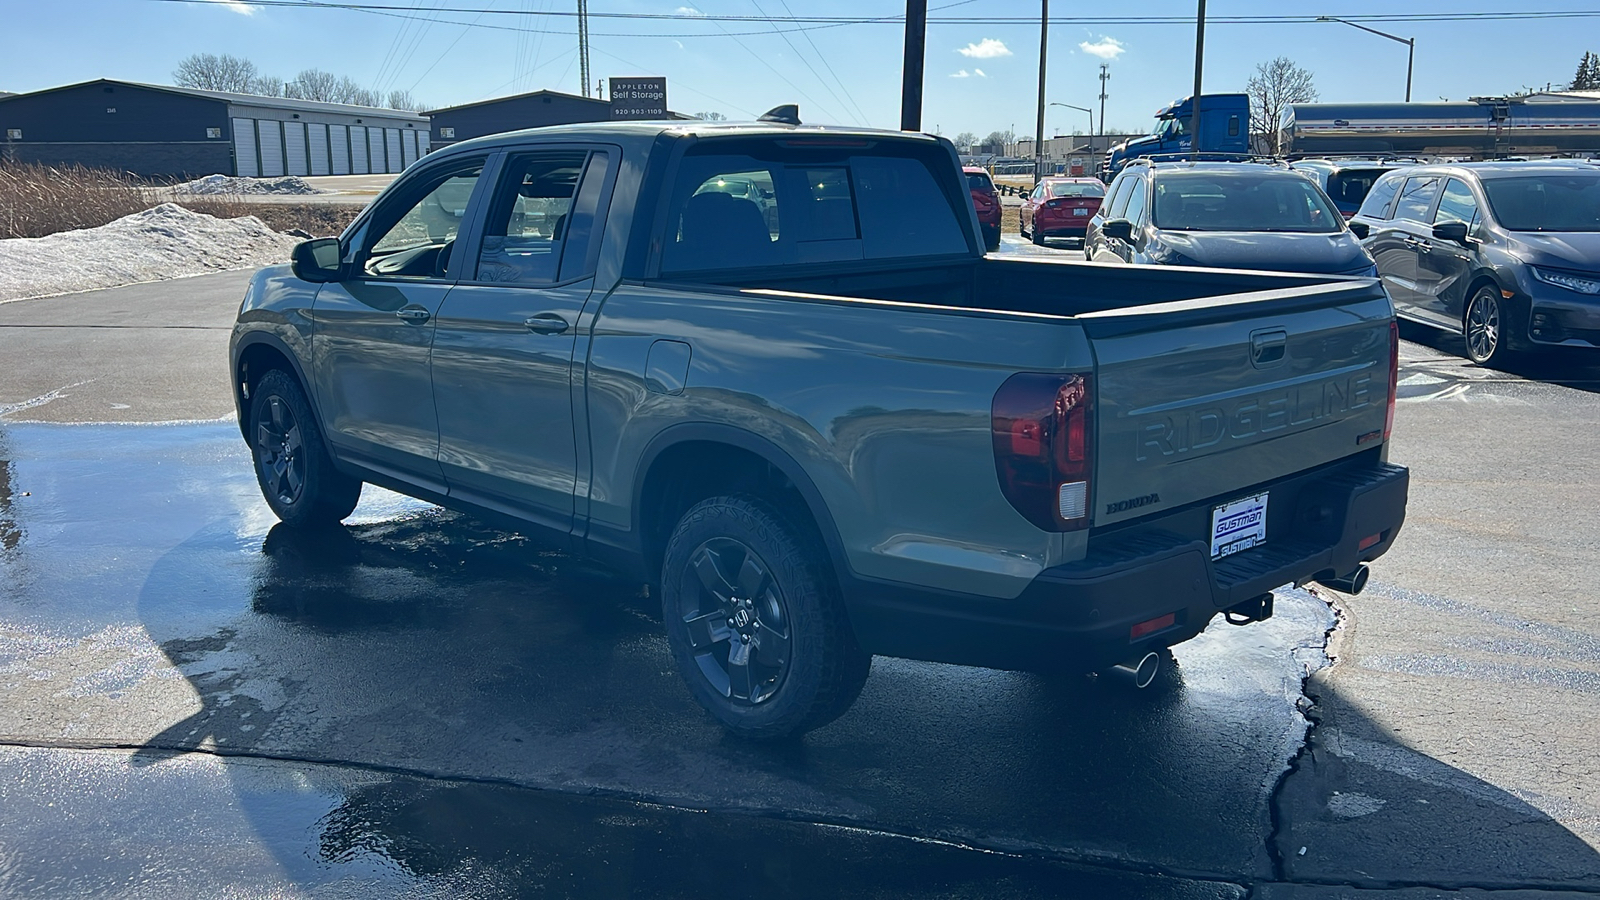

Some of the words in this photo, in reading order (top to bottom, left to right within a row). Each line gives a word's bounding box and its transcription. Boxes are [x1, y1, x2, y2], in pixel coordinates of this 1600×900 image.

[612, 91, 629, 99] Self
[631, 91, 664, 100] Storage
[1136, 371, 1372, 462] RIDGELINE
[1106, 493, 1161, 515] HONDA
